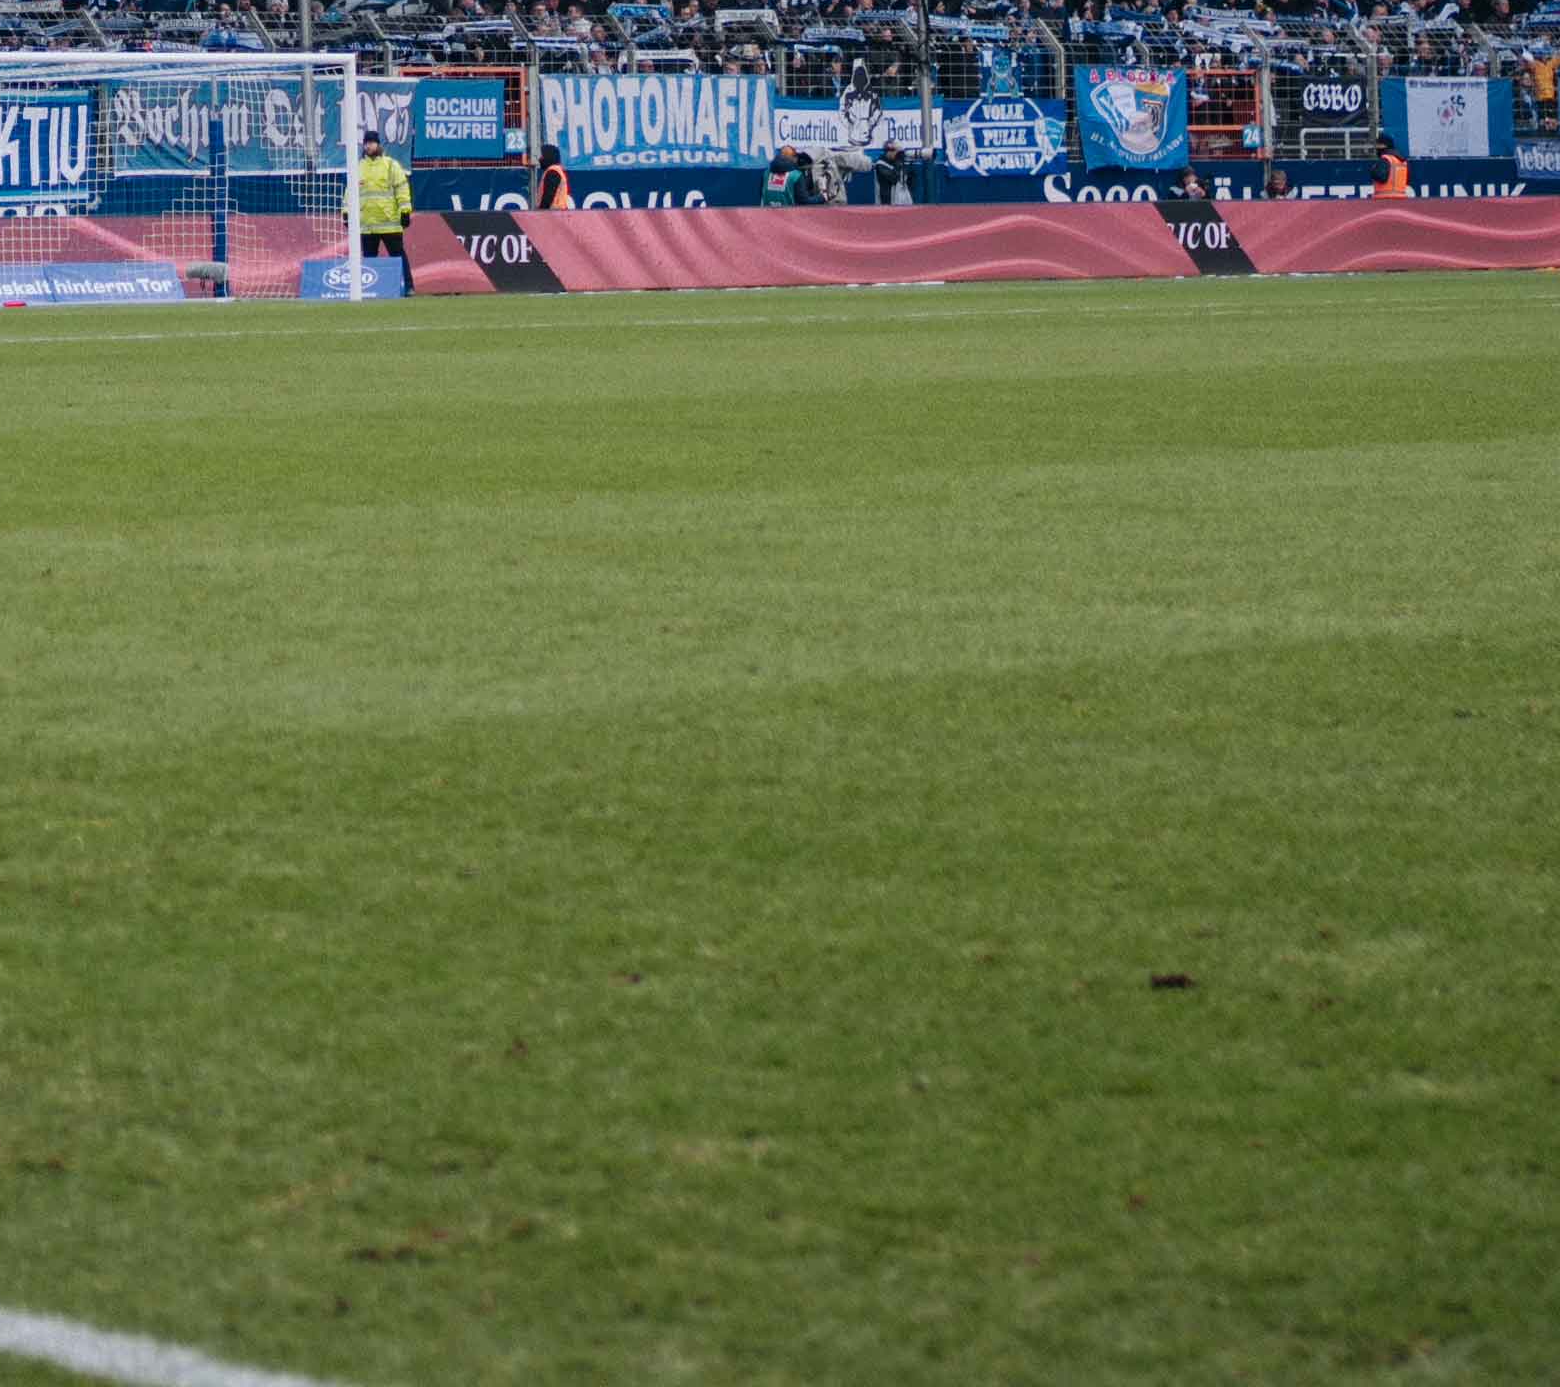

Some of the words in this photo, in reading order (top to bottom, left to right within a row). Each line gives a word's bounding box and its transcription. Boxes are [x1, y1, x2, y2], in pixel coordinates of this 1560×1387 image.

[425, 97, 497, 116] BOCHUM
[981, 102, 1025, 121] VOLLE
[542, 76, 775, 161] PHOTOMAFIA
[425, 122, 497, 140] NAZIFREI
[779, 115, 839, 143] Cuadrilla
[983, 129, 1027, 147] PULLE
[1245, 128, 1260, 145] 24
[506, 132, 525, 150] 23
[593, 150, 730, 166] BOCHUM
[978, 152, 1038, 171] BOCHUM
[53, 276, 134, 296] hinterm
[135, 276, 174, 295] Tor
[327, 269, 373, 285] Seo
